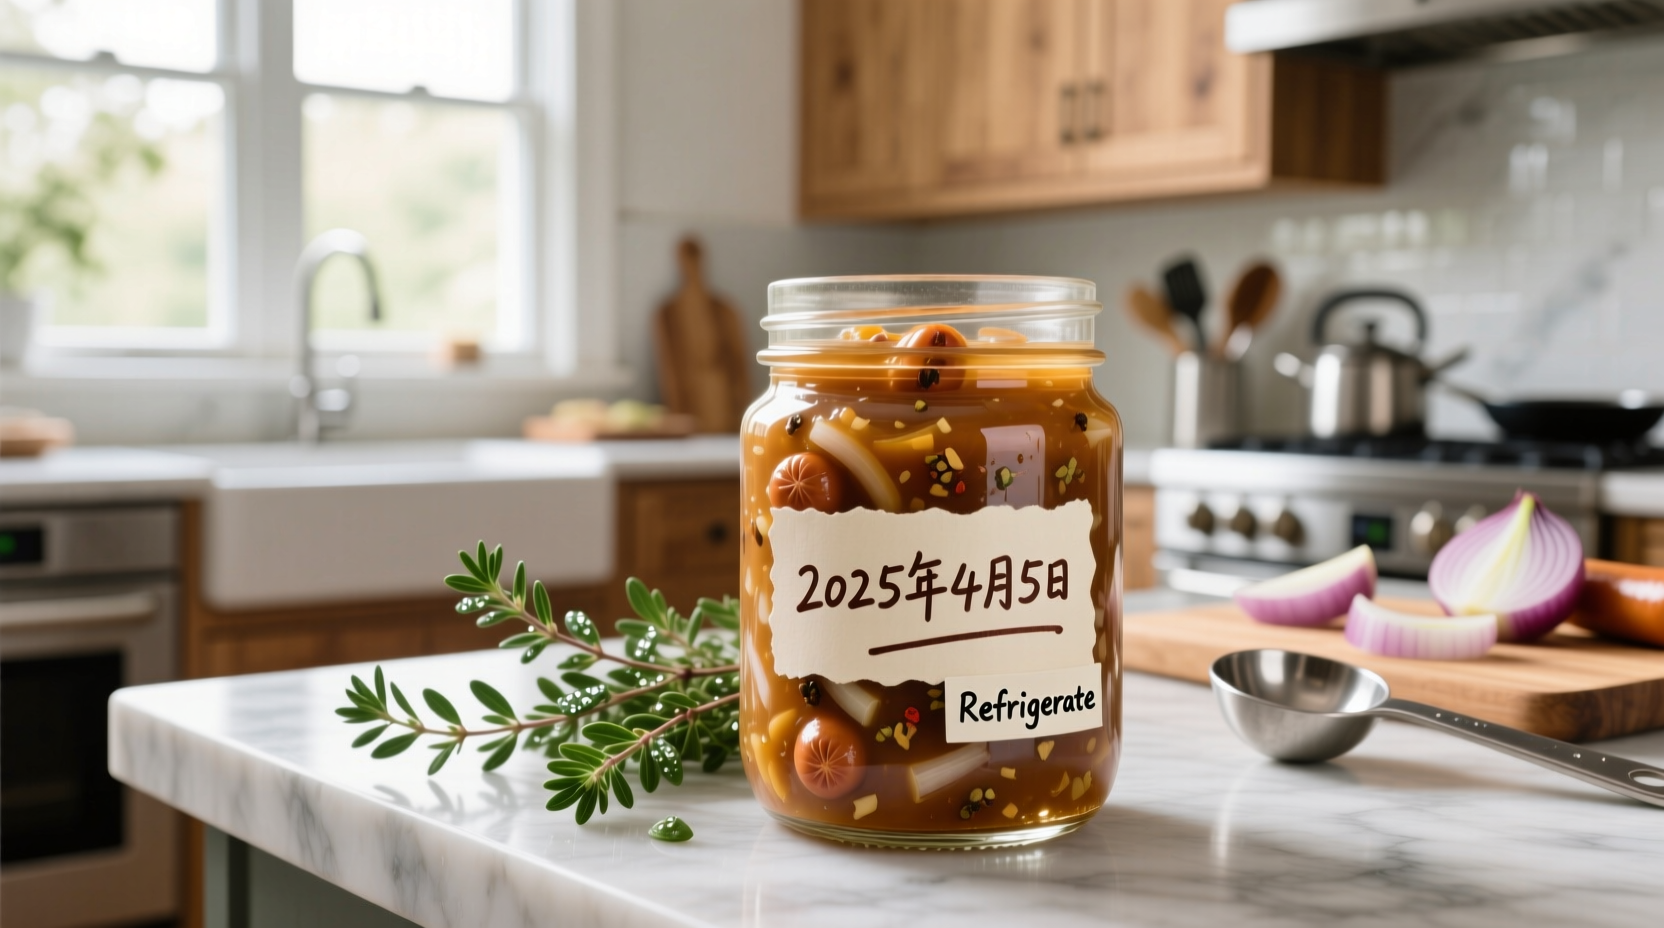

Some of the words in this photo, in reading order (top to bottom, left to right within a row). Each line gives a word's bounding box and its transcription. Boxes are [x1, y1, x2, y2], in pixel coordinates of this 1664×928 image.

[796, 550, 1069, 622] 2025年4月5日
[959, 685, 1096, 730] Refrigerate
